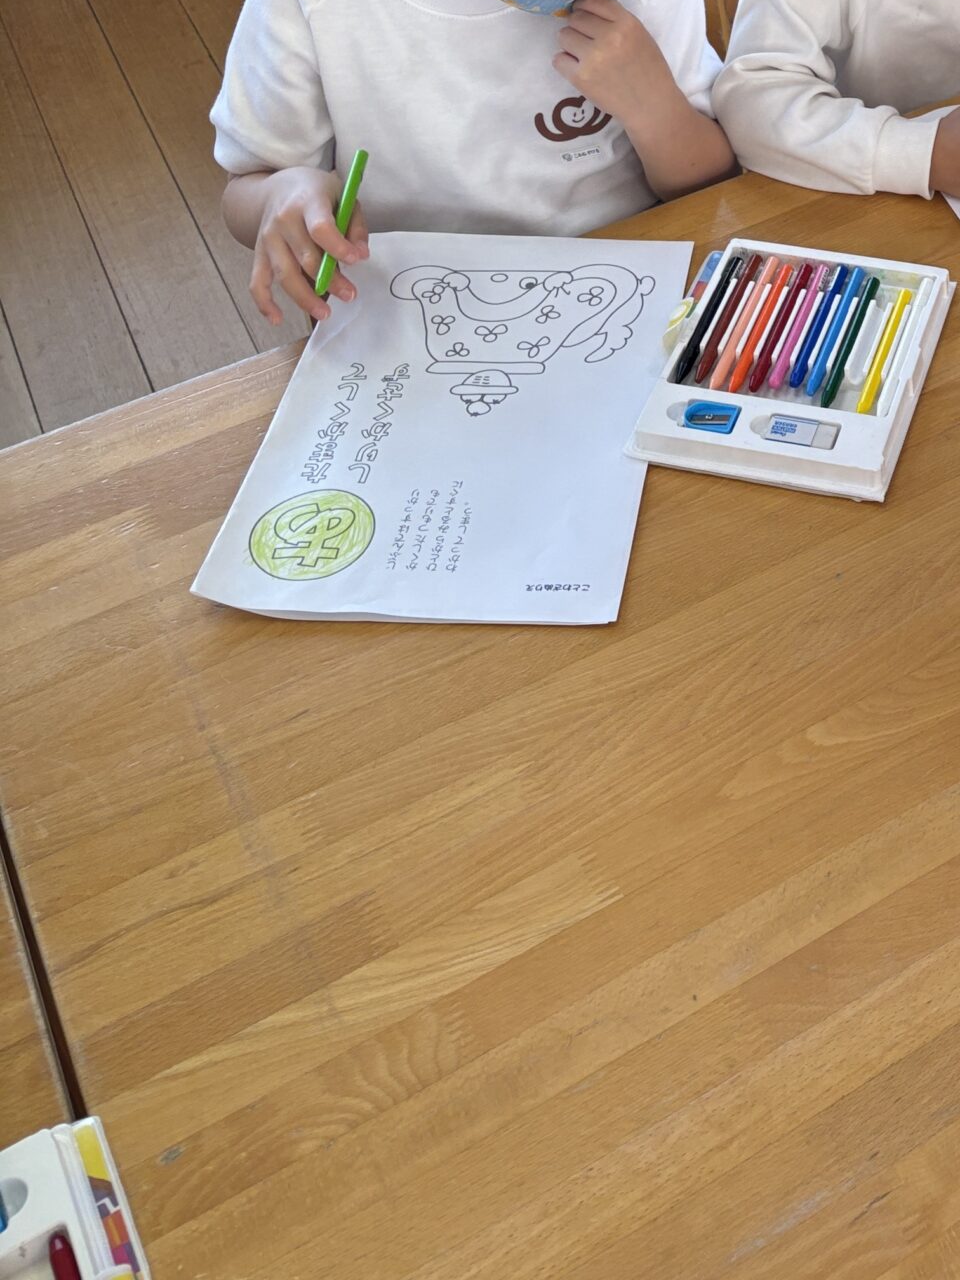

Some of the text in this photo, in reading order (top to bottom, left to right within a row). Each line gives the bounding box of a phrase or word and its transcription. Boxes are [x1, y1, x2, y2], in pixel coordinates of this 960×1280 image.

[272, 362, 367, 568] あ たまかくして
[347, 362, 411, 484] しりかくさず
[524, 583, 591, 592] ことわざぬりえ
